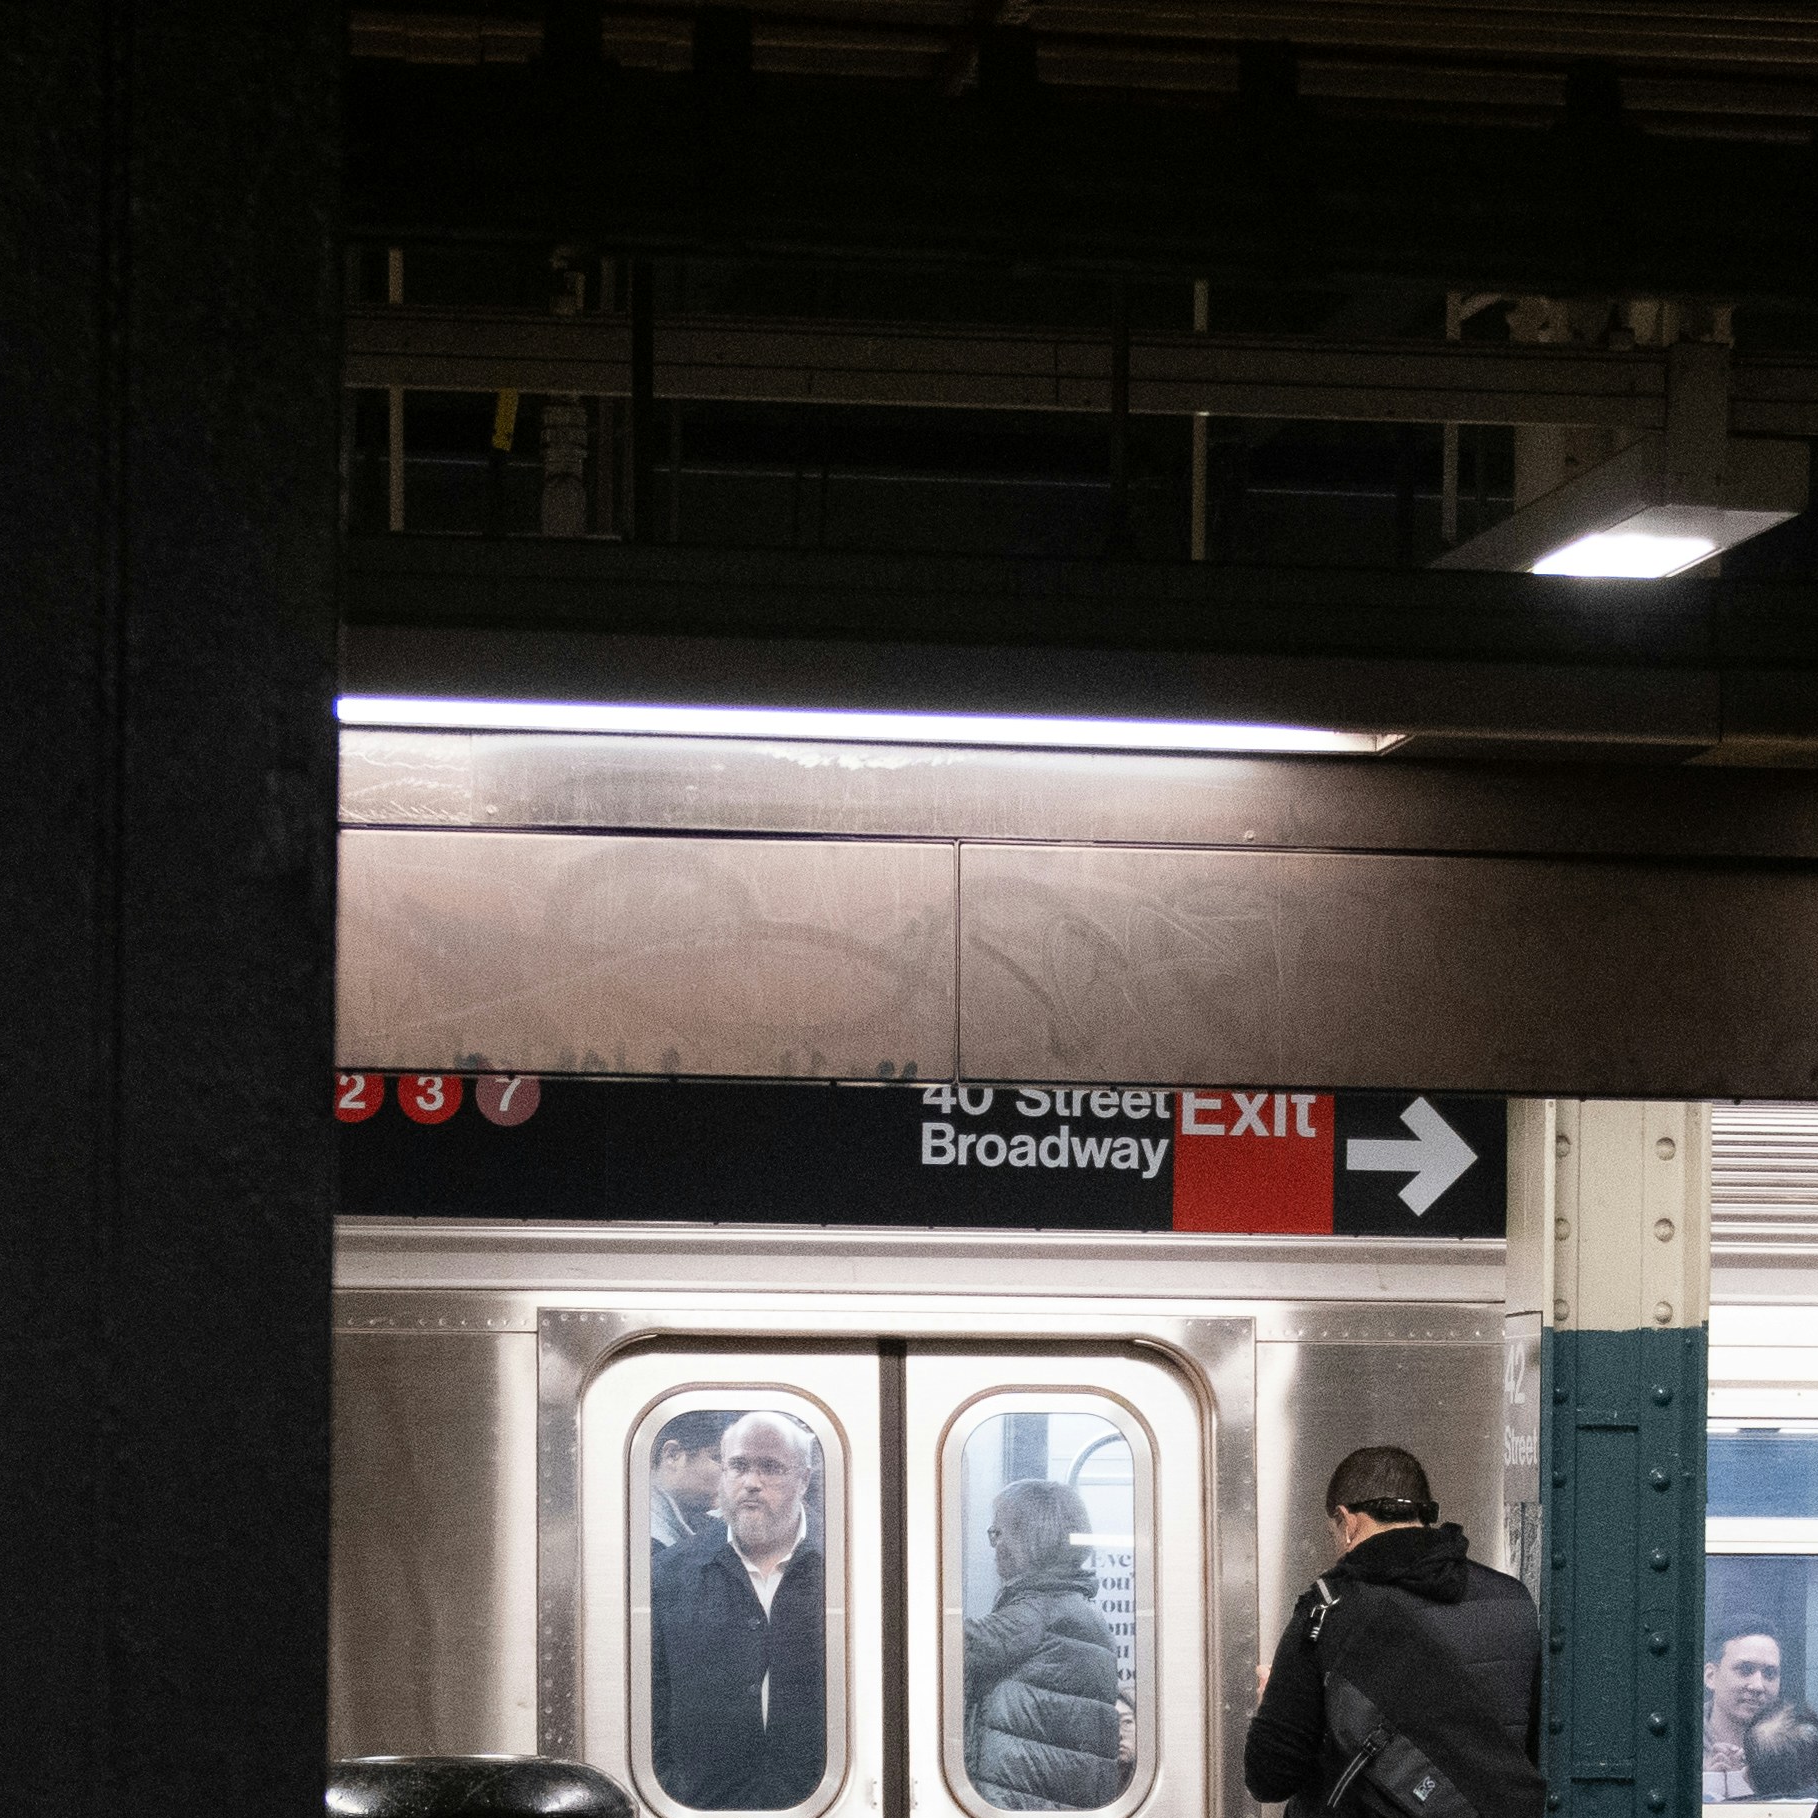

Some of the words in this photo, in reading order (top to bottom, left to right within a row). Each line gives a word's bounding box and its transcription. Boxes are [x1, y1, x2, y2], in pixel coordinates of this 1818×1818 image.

[339, 1074, 366, 1109] 2
[416, 1076, 445, 1111] 3
[496, 1076, 522, 1112] 7
[1015, 1088, 1171, 1119] Street
[1182, 1092, 1315, 1138] Exit
[921, 1122, 1170, 1180] Broadway
[1504, 1341, 1526, 1404] 42
[1504, 1424, 1539, 1467] Street
